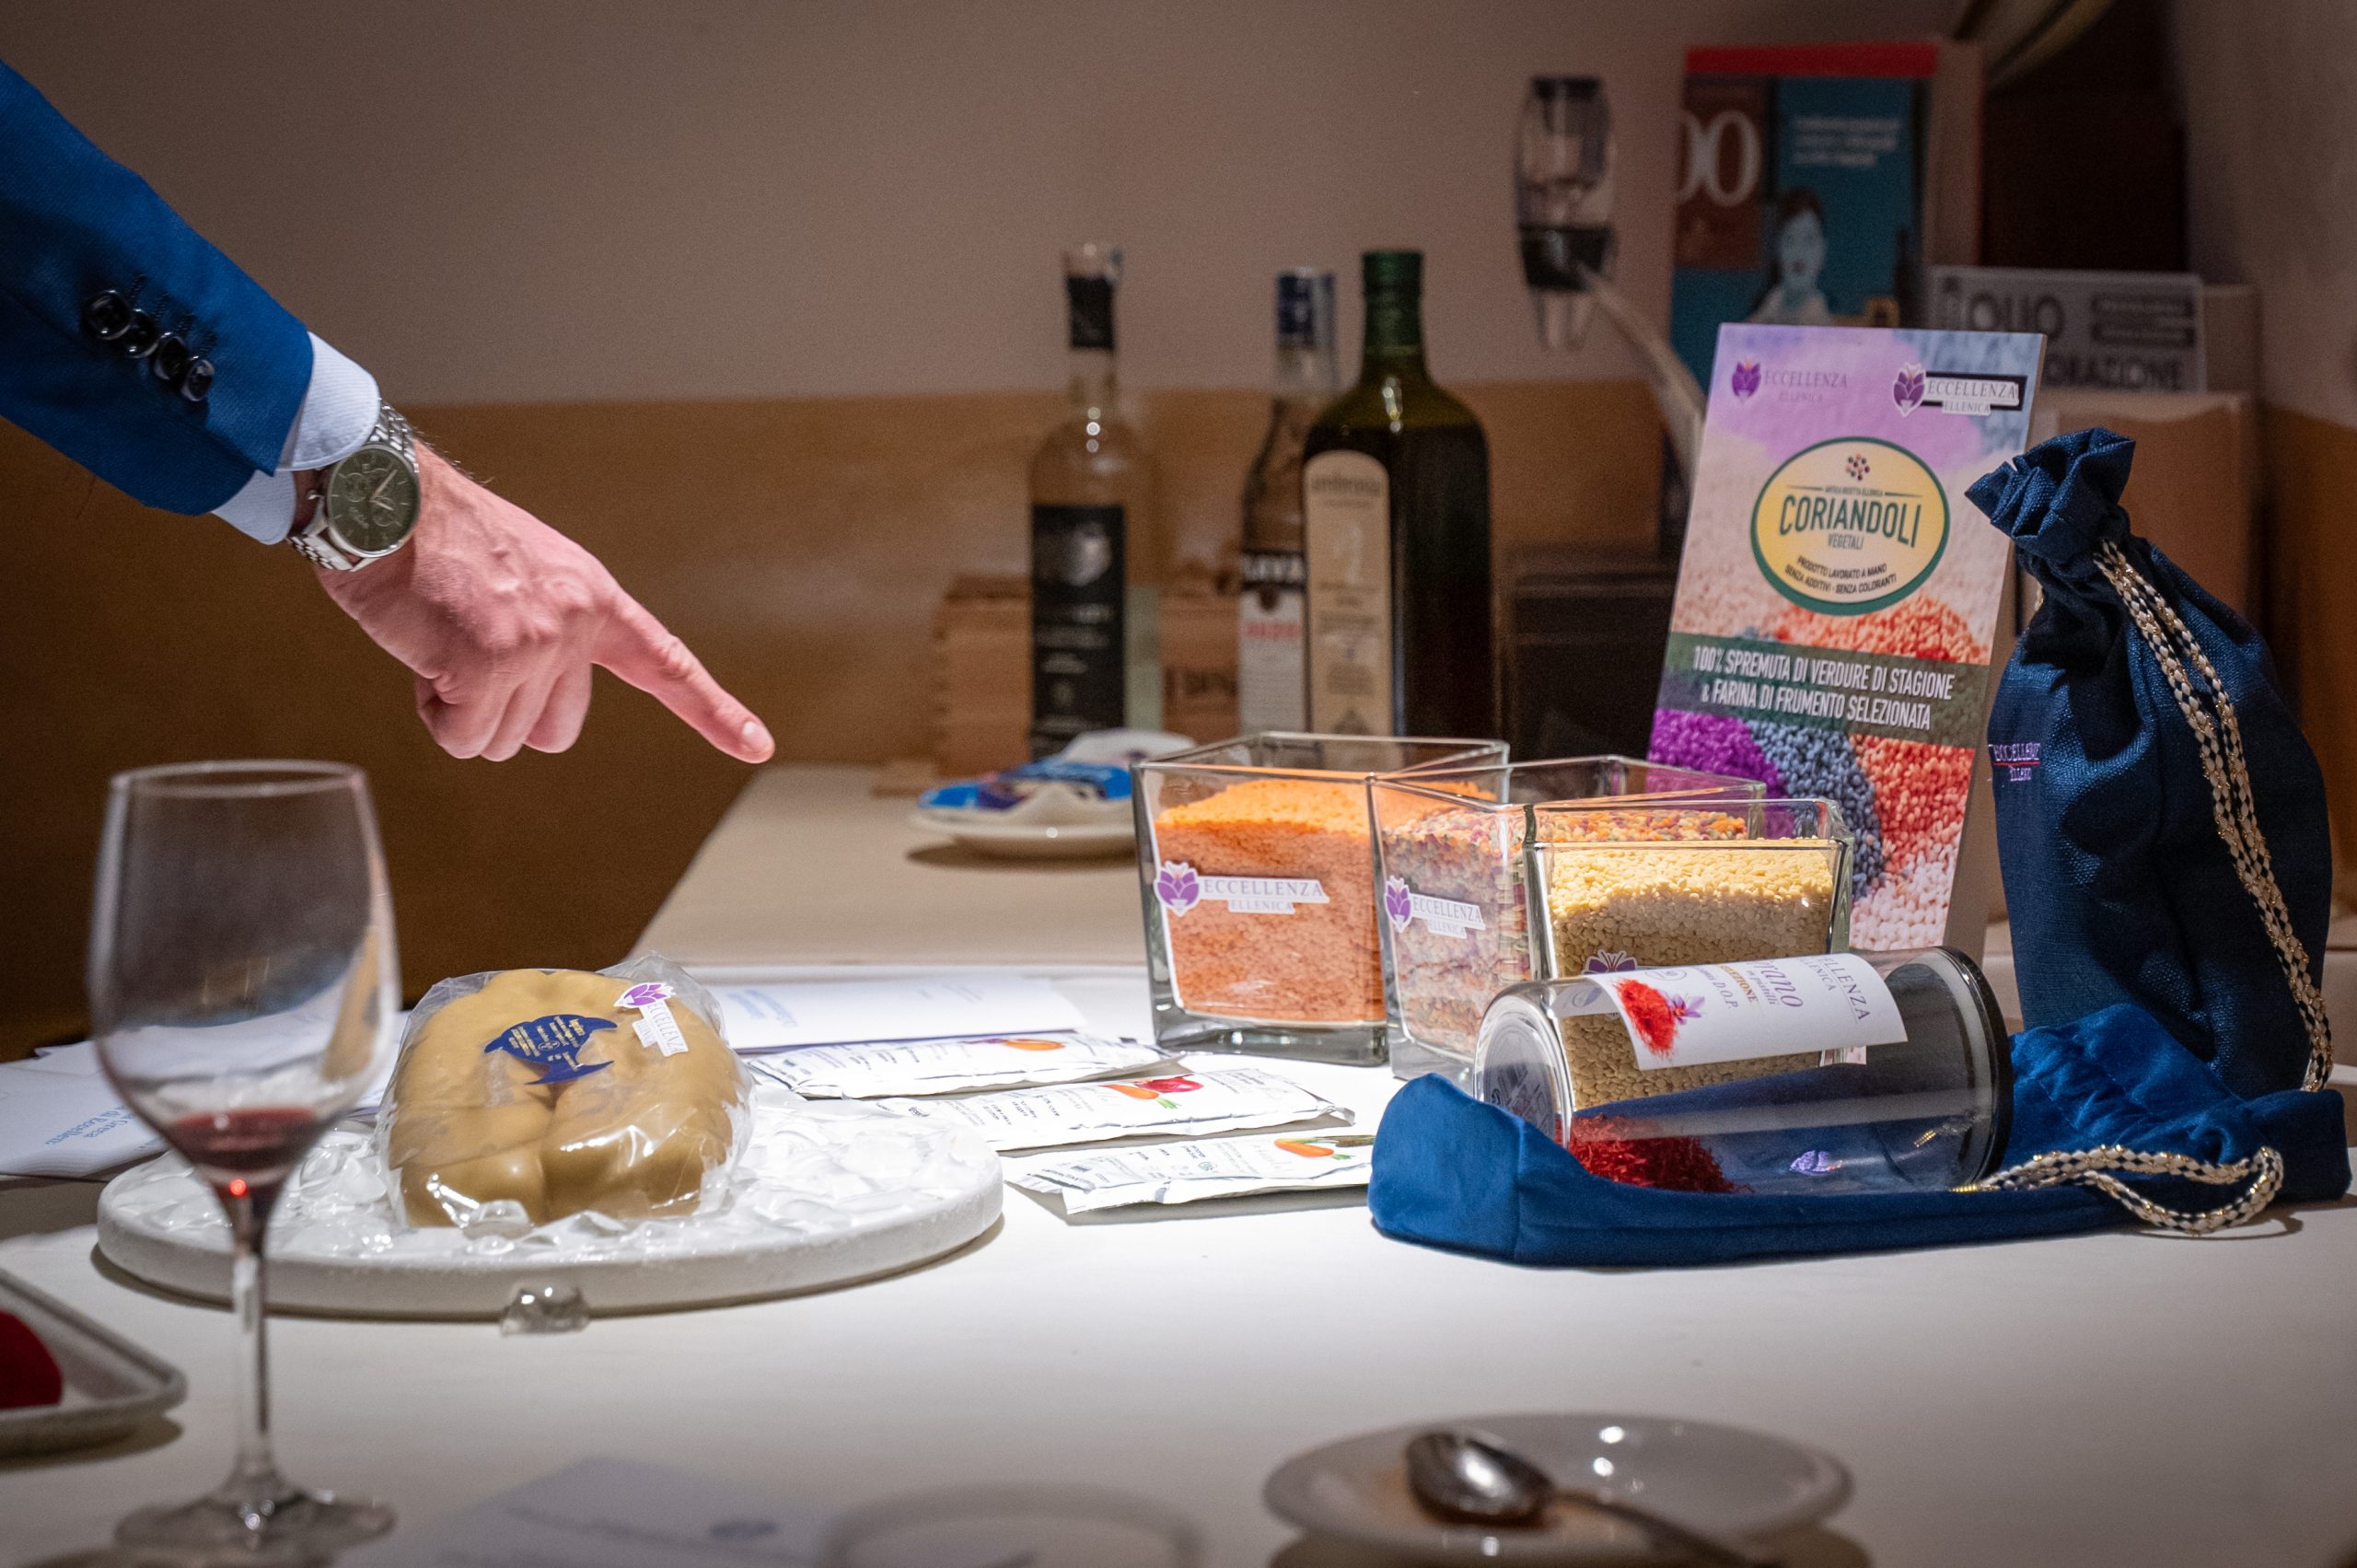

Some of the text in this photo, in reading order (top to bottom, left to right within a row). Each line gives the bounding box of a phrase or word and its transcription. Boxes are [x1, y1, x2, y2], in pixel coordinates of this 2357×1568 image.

[1764, 369, 1848, 388] ECCELLENZA
[1928, 380, 2015, 399] ECCELLENZA
[1944, 401, 1990, 413] ELLENICA
[1779, 494, 1922, 548] CORIANDOLI
[1828, 533, 1864, 550] VEGETALI
[1785, 563, 1805, 582] SENZA
[1805, 576, 1831, 591] ADDITIVI
[1836, 583, 1857, 594] SENZA
[1859, 573, 1897, 593] COLORANTI
[1797, 555, 1828, 577] PRODOTTO
[1829, 566, 1860, 580] LAVORATO
[1867, 563, 1887, 576] MANO
[1693, 645, 1956, 700] 100% SPREMUTA DI VERDURE DI STAGIONE
[1701, 678, 1931, 730] & FARINA DI FRUMENTO SELEZIONATA
[1203, 878, 1323, 897] ECCELLENZA
[1230, 900, 1294, 911] ELLENICA
[1412, 897, 1482, 923] ECCELLENZA
[1713, 981, 1739, 1009] D.O.P.
